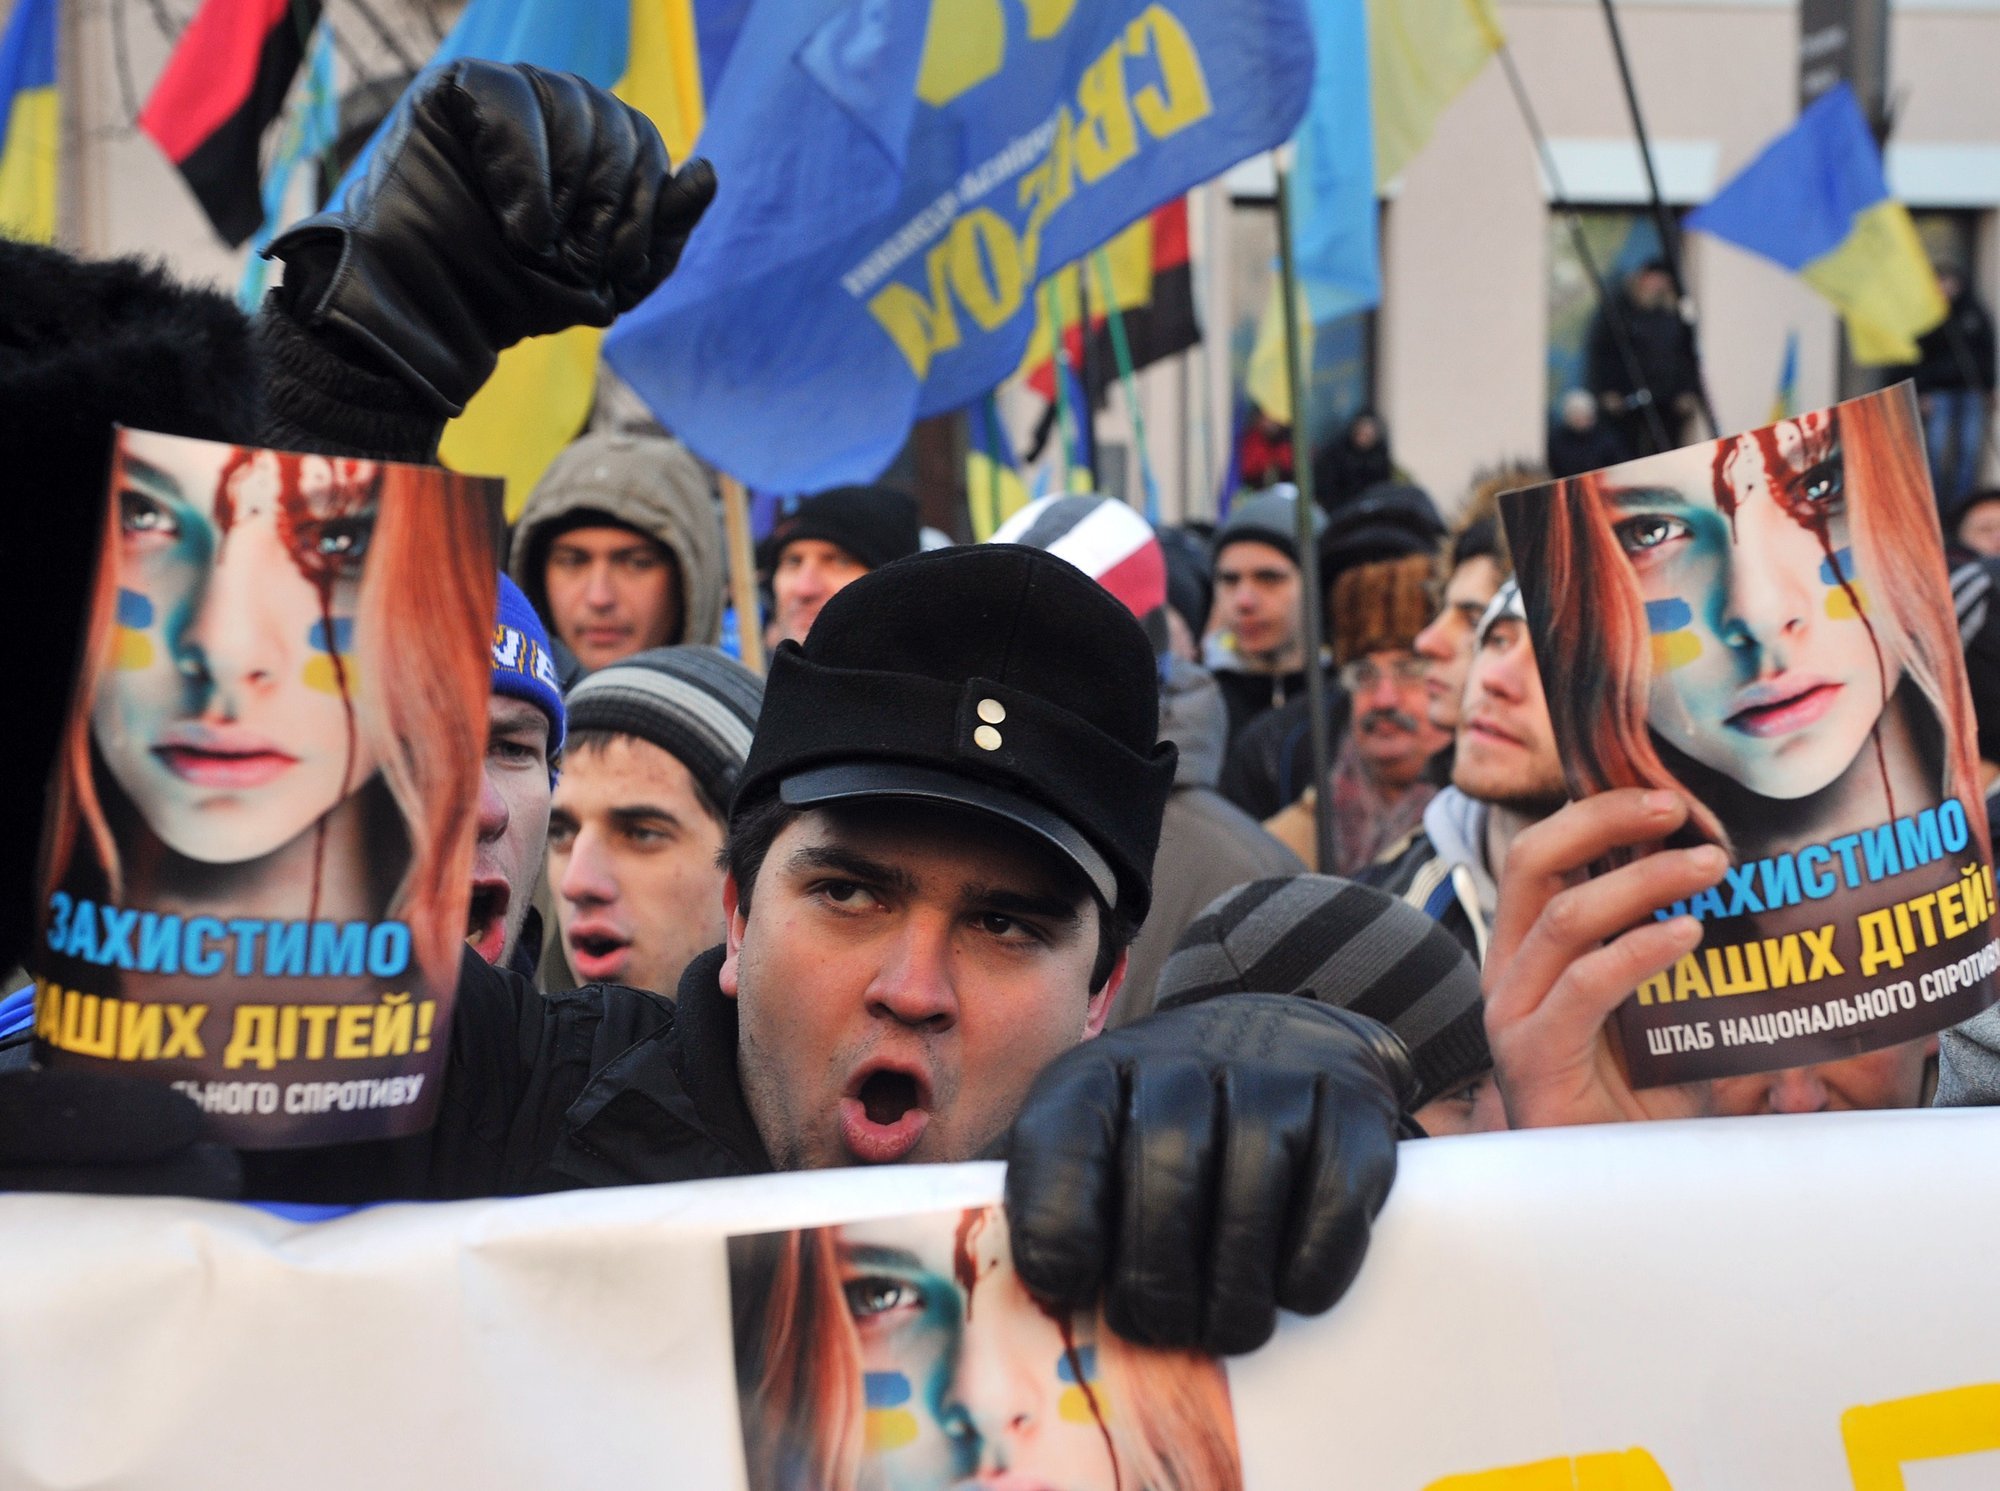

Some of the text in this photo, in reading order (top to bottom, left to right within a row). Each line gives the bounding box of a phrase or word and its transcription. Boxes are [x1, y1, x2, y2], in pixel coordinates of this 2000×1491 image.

[47, 890, 411, 978] ЗАХИСТИМО
[1857, 862, 1997, 977] ДІТЕЙ!
[223, 991, 436, 1070] ДІТЕЙ!
[1646, 1022, 1715, 1056] ШТАБ
[1719, 980, 1917, 1046] НАЦІОНАЛЬНОГО
[284, 1073, 425, 1114] СПРОТИВУ
